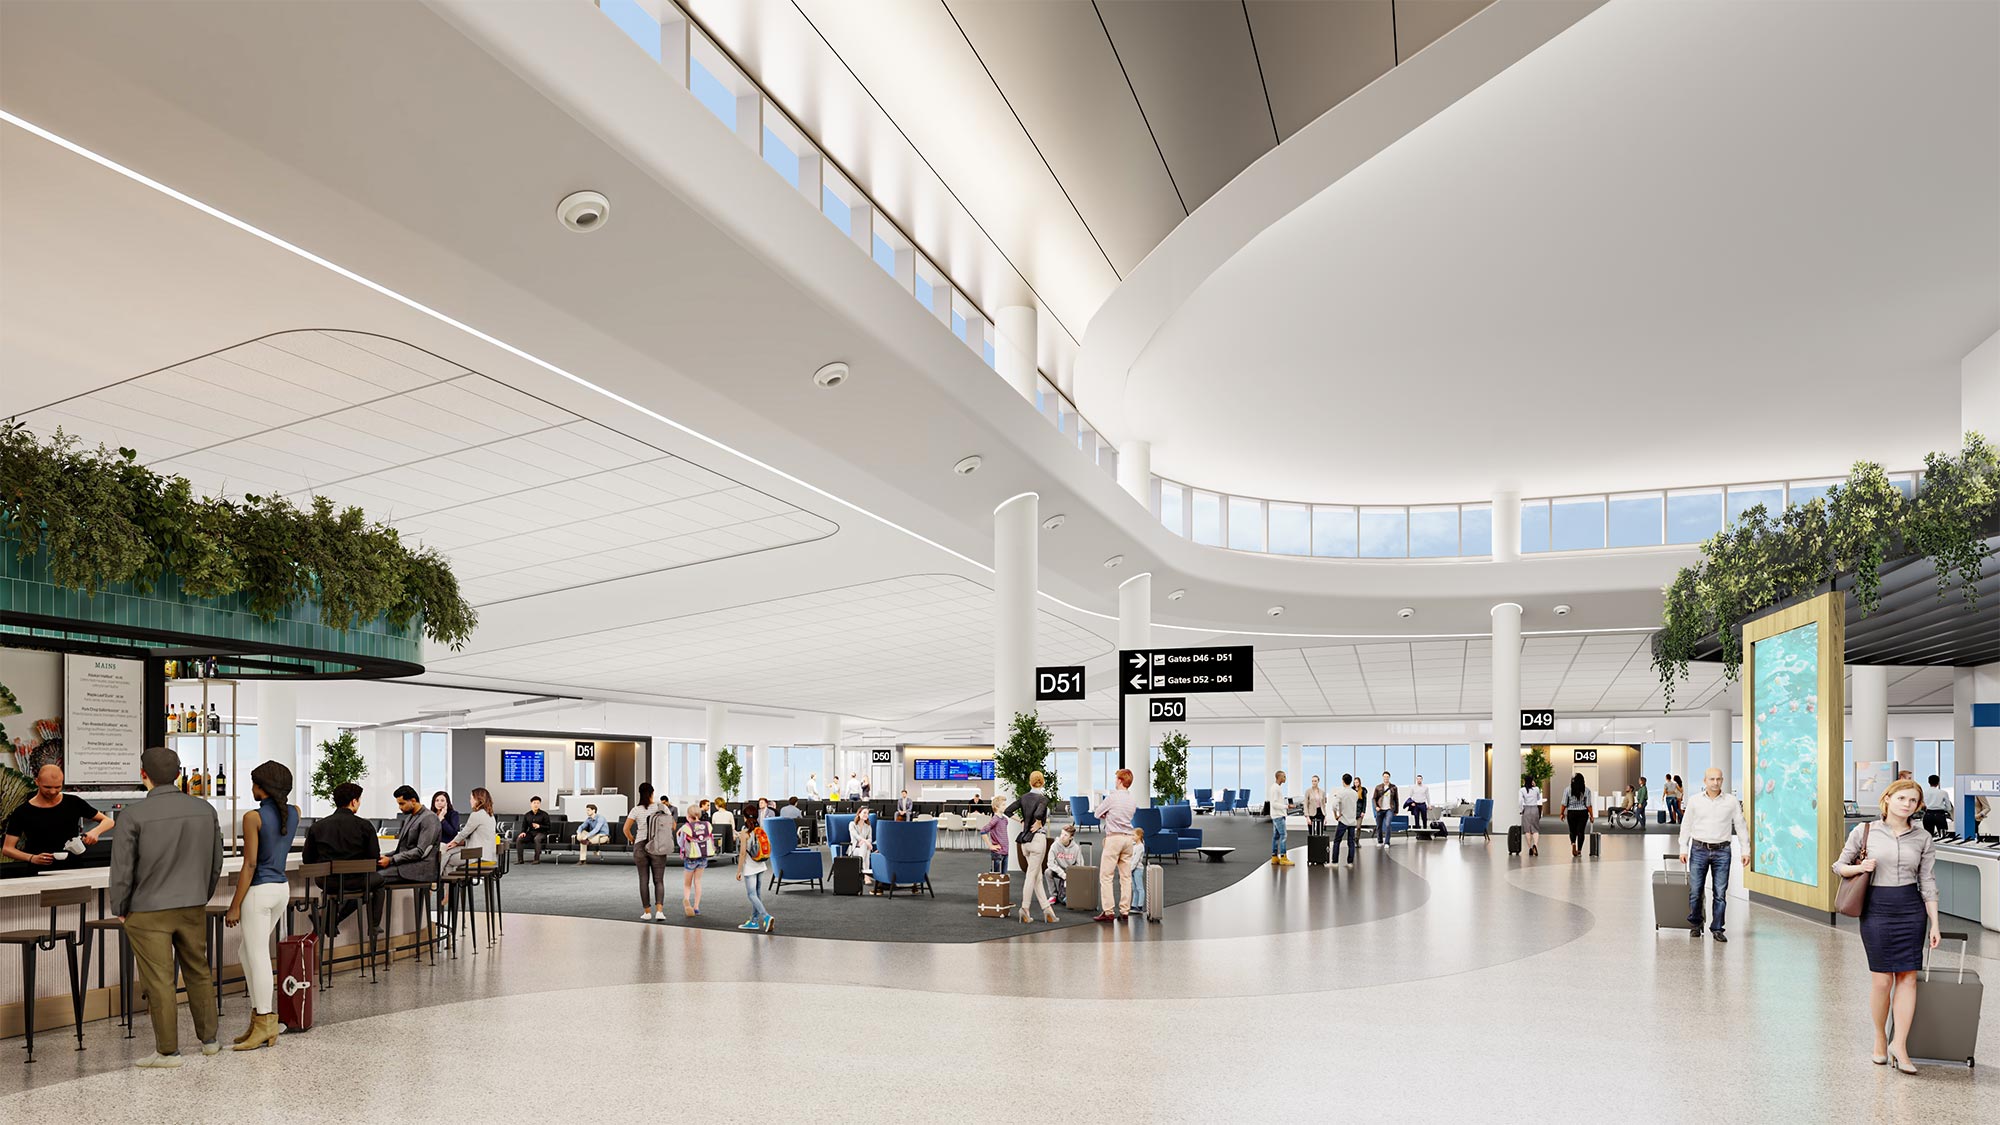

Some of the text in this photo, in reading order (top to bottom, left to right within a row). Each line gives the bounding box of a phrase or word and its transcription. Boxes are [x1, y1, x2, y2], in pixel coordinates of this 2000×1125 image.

[1167, 654, 1191, 664] Gates
[1192, 653, 1209, 663] D46
[1216, 652, 1233, 662] D51
[95, 662, 117, 670] MAINS
[1039, 672, 1081, 694] D51
[1167, 676, 1191, 685] Gates
[1192, 675, 1209, 684] D52
[1216, 674, 1233, 684] D61
[1151, 701, 1184, 717] D50
[1522, 713, 1553, 726] D49
[577, 745, 594, 757] D51
[873, 752, 890, 761] D50
[1575, 751, 1597, 761] D49
